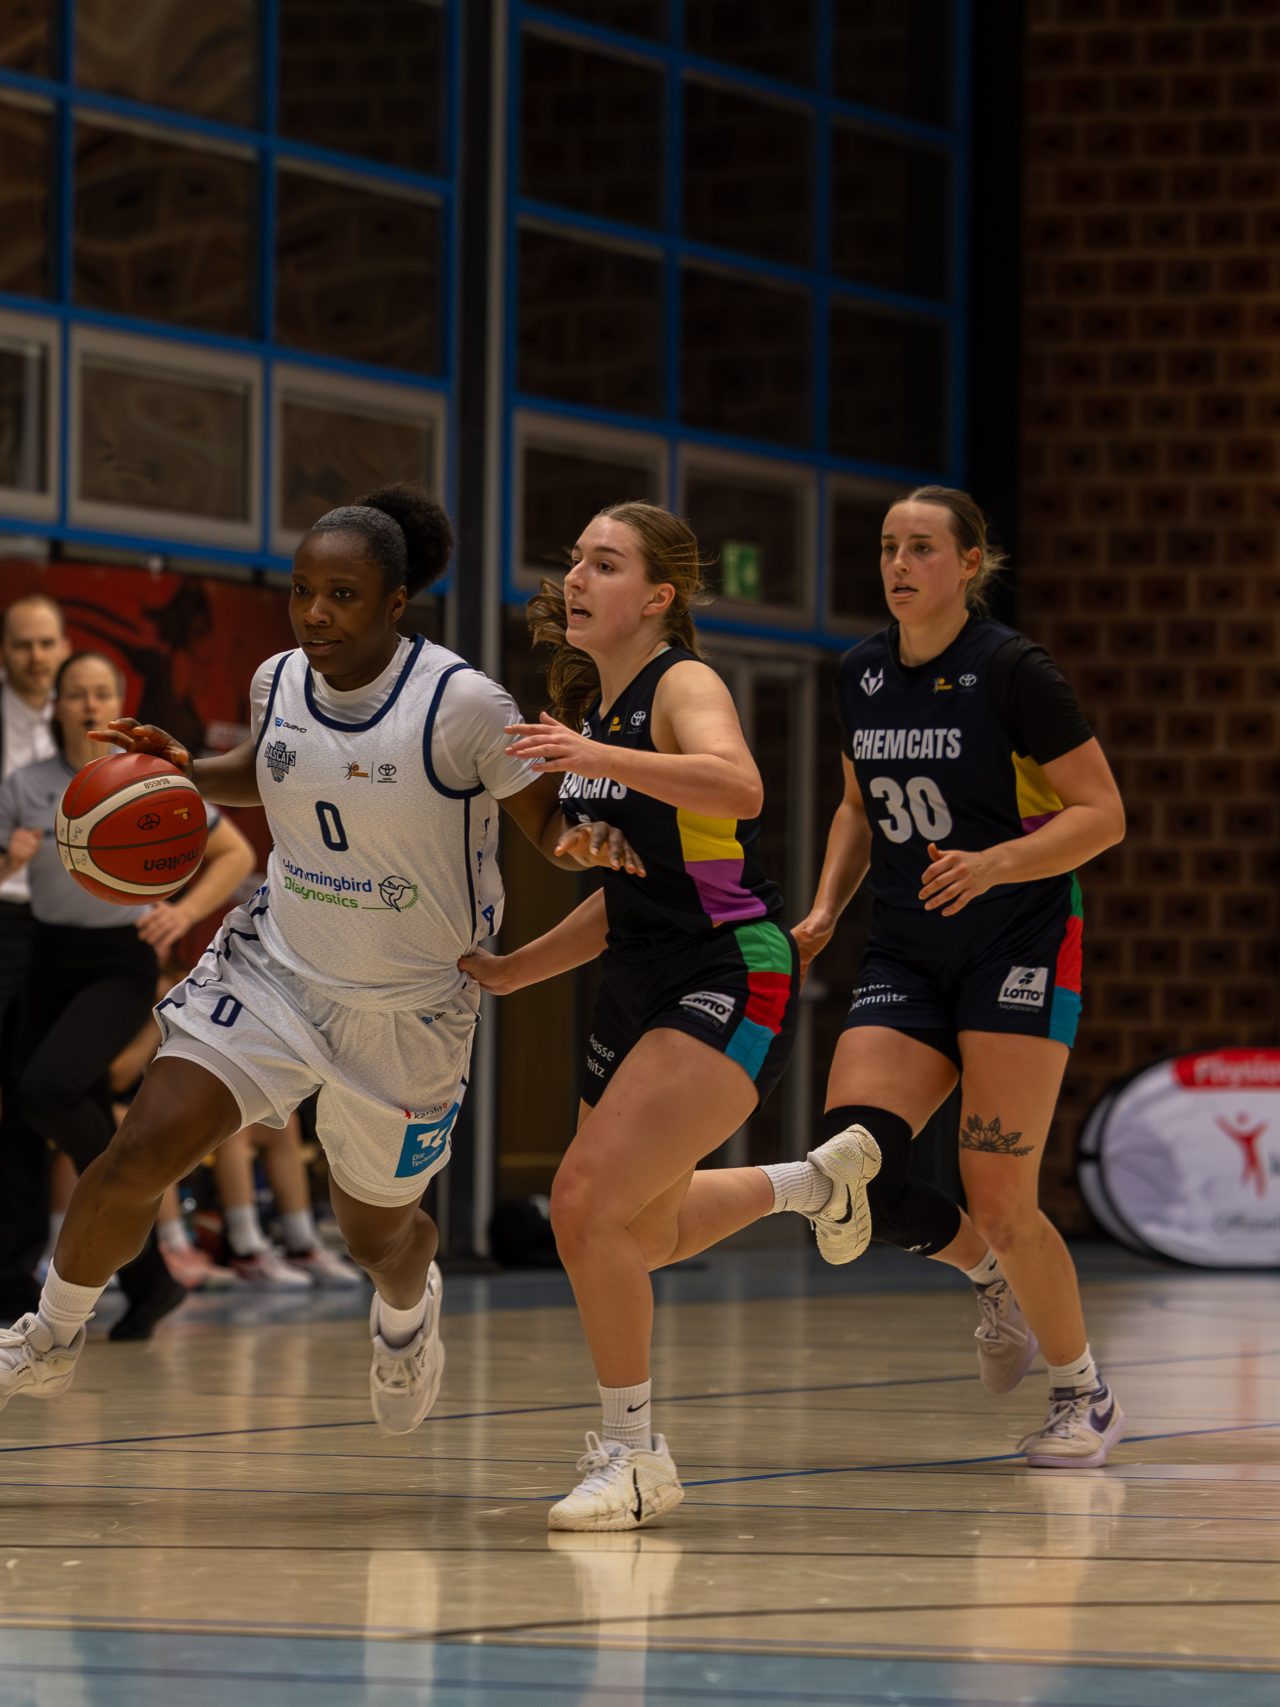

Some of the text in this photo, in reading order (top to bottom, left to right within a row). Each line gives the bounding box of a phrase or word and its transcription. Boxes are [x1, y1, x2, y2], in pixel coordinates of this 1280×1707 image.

[852, 727, 963, 761] CHEMCATS
[315, 800, 349, 852] 0
[869, 775, 953, 845] 30
[143, 847, 199, 872] molten
[284, 875, 359, 909] Diagnostics
[210, 994, 244, 1028] 0
[848, 992, 908, 1016] emnitz
[1003, 987, 1041, 1001] LOTTO
